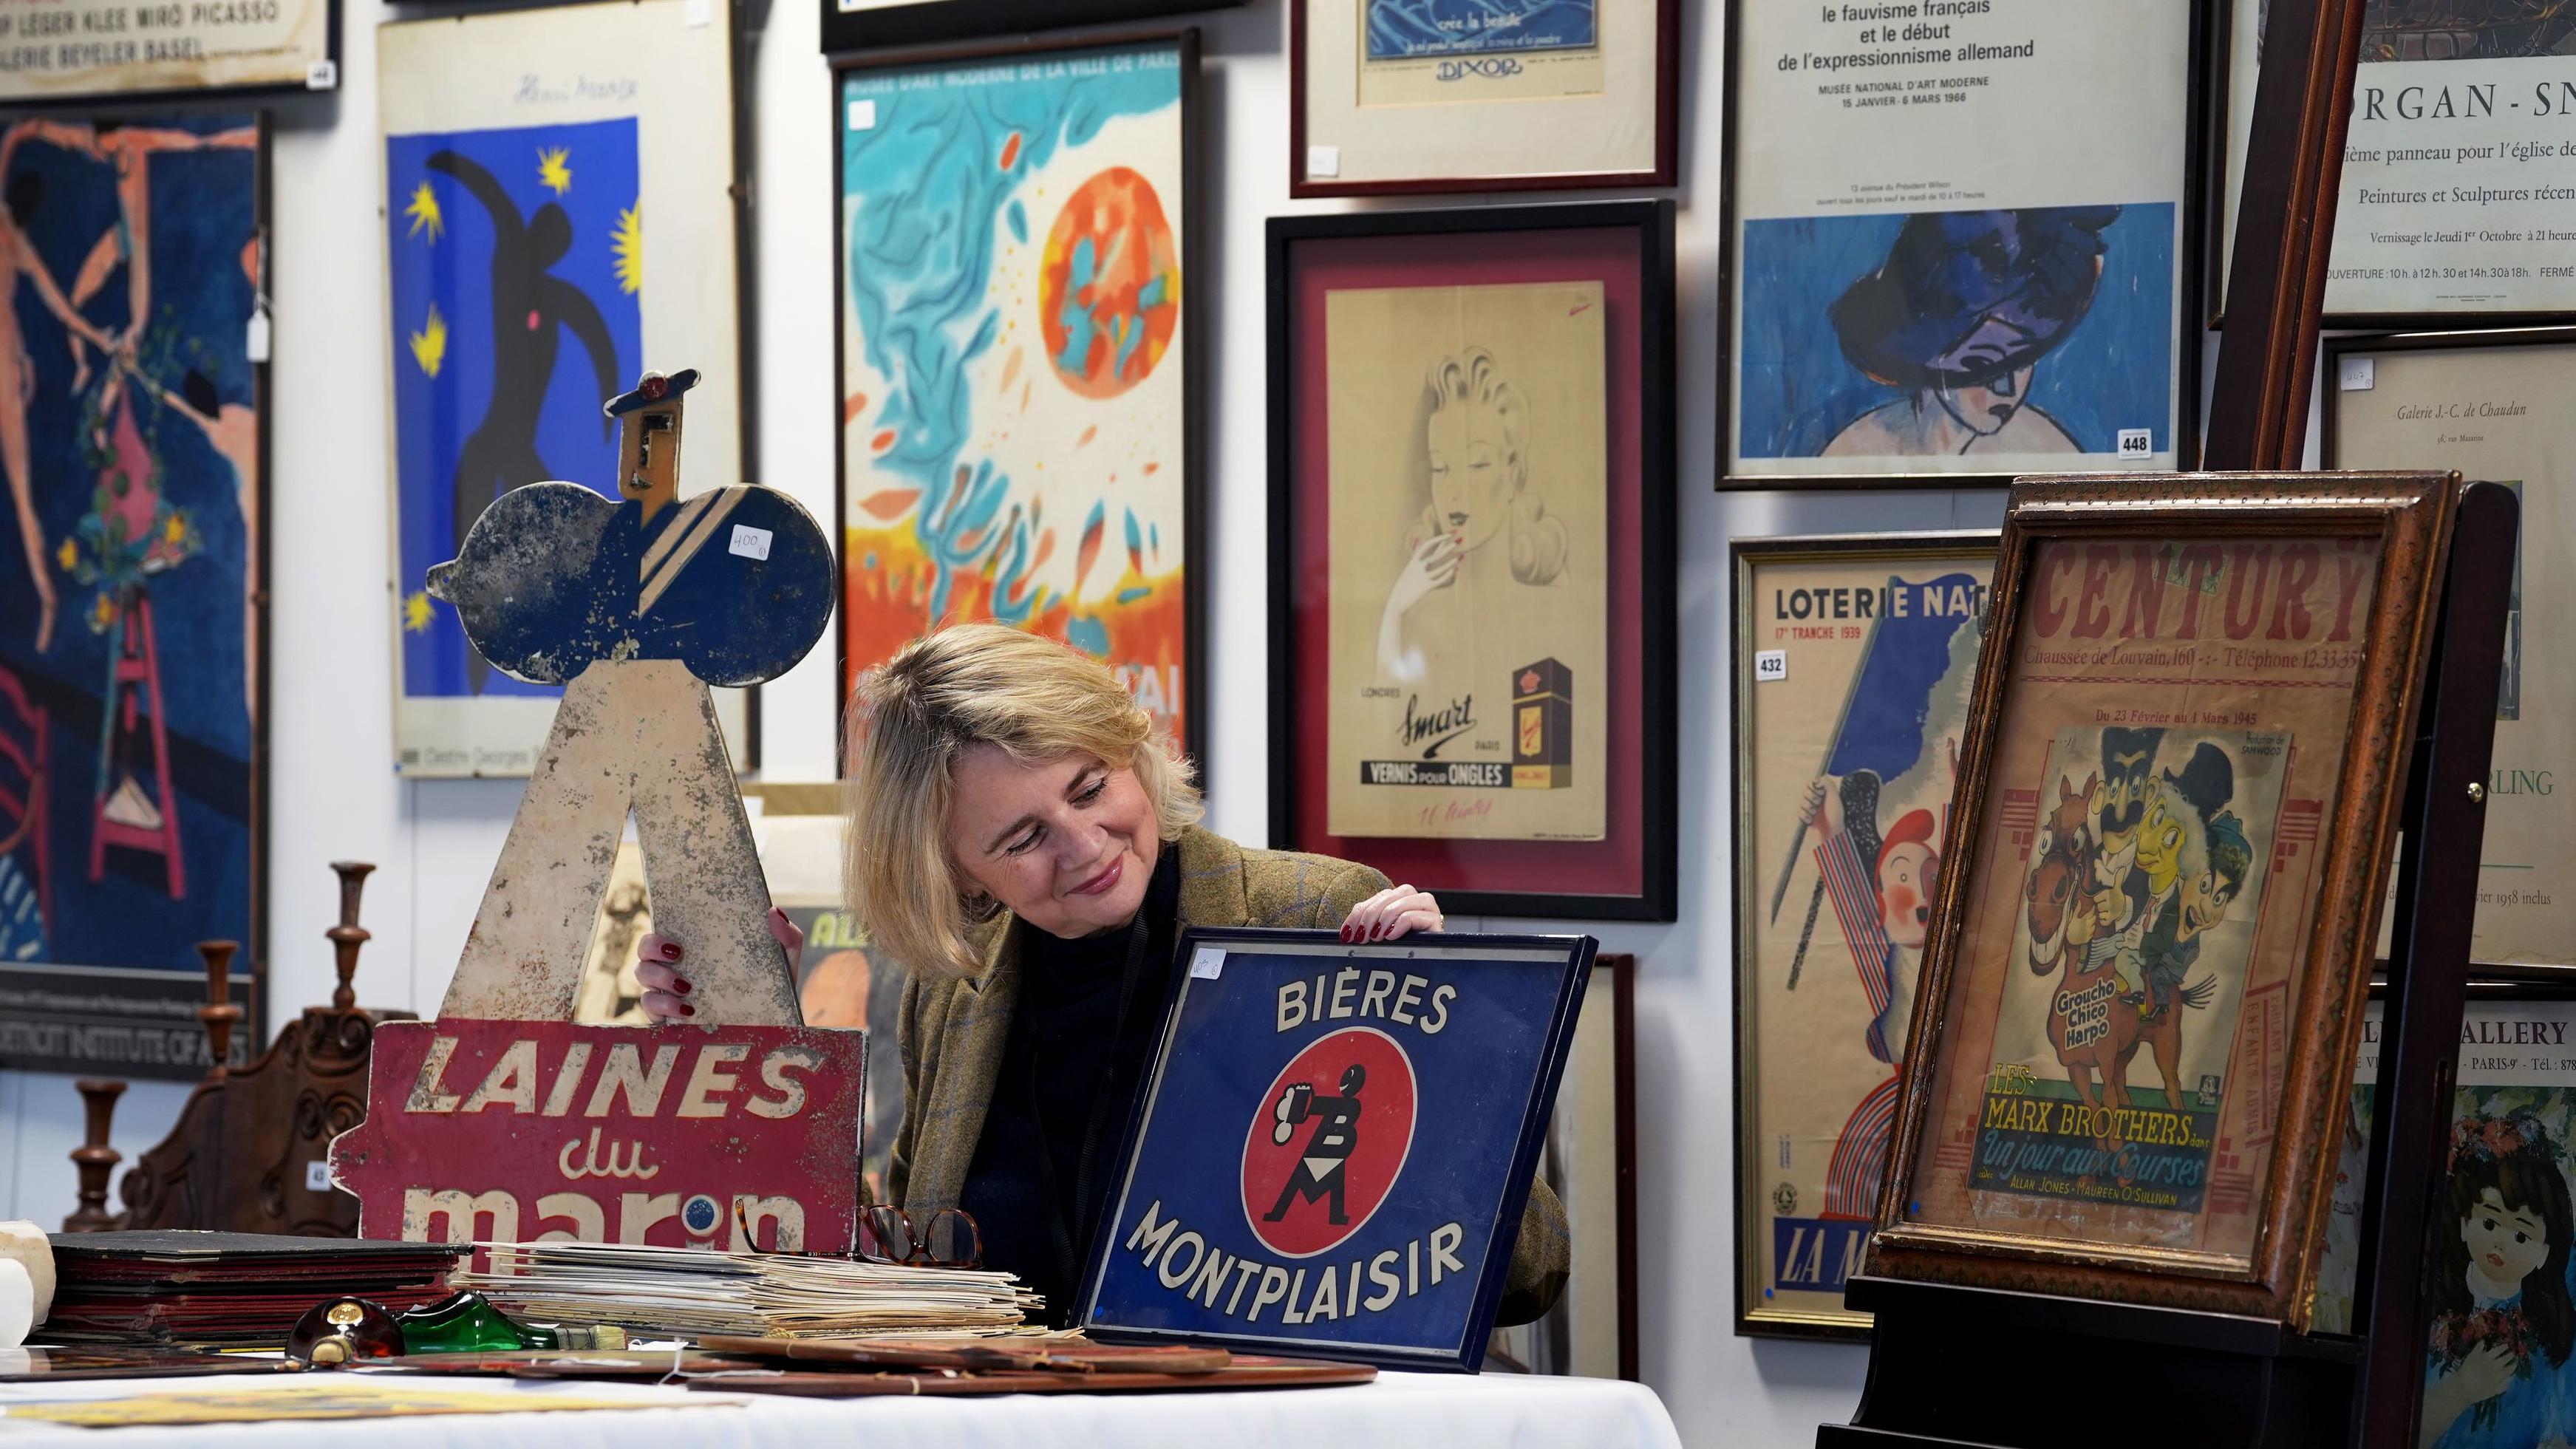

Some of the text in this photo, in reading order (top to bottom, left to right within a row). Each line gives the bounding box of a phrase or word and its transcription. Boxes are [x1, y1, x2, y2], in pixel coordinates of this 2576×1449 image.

[191, 0, 279, 26] PICASSO
[1468, 10, 1479, 29] la
[1482, 10, 1521, 28] beauté
[1822, 0, 1991, 23] le fauvisme français
[1860, 23, 1951, 44] et le début
[143, 38, 205, 63] BASEL
[1777, 39, 2034, 72] de l'expressionnisme allemand
[1020, 64, 1040, 81] DE
[1046, 61, 1065, 78] LA
[1069, 57, 1107, 76] VILLE
[1112, 55, 1133, 73] DE
[1138, 50, 1180, 69] PARIS
[1436, 58, 1524, 81] DIXOR
[1818, 76, 1990, 95] MUSÉE NATIONAL D'ART MODERNE
[1842, 92, 1966, 109] 15 JANVIER 6 MARS 1966
[2386, 147, 2451, 165] panneau
[2457, 148, 2492, 164] pour
[2499, 141, 2554, 163] l'église
[1928, 180, 1951, 188] Wilson
[2359, 187, 2427, 205] Peintures
[2432, 188, 2446, 203] et
[2452, 186, 2529, 207] Sculptures
[2370, 231, 2422, 245] Vernissage
[2424, 231, 2433, 243] le
[2433, 231, 2461, 243] Jeudi
[2479, 231, 2521, 242] Octobre
[2527, 231, 2533, 242] à
[2535, 231, 2546, 241] 21
[2413, 268, 2418, 279] à
[2459, 269, 2467, 279] et
[2540, 265, 2575, 278] FERMÉ
[2396, 405, 2433, 420] Galerie
[2464, 403, 2476, 419] de
[2480, 400, 2526, 417] Chaudun
[2123, 437, 2147, 451] 448
[2459, 434, 2484, 443] Mazarine
[734, 534, 757, 547] 400
[2032, 539, 2380, 641] CENTURY
[1776, 587, 1908, 620] LOTERIE
[1792, 627, 1834, 639] TRANCHE
[1840, 626, 1861, 639] 1939
[1760, 658, 1782, 672] 432
[2024, 645, 2089, 665] Chaussée
[2091, 647, 2108, 666] de
[2224, 648, 2299, 670] Téléphone
[1397, 693, 1477, 755] Smart
[2096, 709, 2257, 726] Du 23 Février au 1 Mars 1945
[1370, 762, 1419, 784] VERNIS
[1420, 773, 1447, 785] POUR
[1448, 764, 1503, 786] ONGLES
[2496, 889, 2552, 907] 1958 inclus
[1276, 966, 1457, 1034] BIÈRES
[2057, 979, 2116, 1014] Groucho
[2068, 1003, 2108, 1029] Chico
[68, 1024, 196, 1066] INSTITUTE OF
[2065, 1020, 2109, 1049] Harpo
[2460, 1020, 2569, 1046] ALLERY
[403, 1036, 828, 1119] LAINES
[1991, 1063, 2031, 1095] LES
[2246, 1002, 2260, 1135] ENFANTS ADMIS
[1985, 1098, 2210, 1149] MARX BROTHERS dans
[558, 1126, 659, 1179] du
[1983, 1129, 2206, 1187] Un jour aux Courses
[2009, 1175, 2035, 1191] ALLAN
[2039, 1177, 2070, 1195] JONES
[2076, 1182, 2119, 1201] MAUREEN
[2122, 1186, 2177, 1207] O'SULLIVAN
[1125, 1199, 1466, 1325] MONTPLAISIR
[1780, 1227, 1827, 1283] LA
